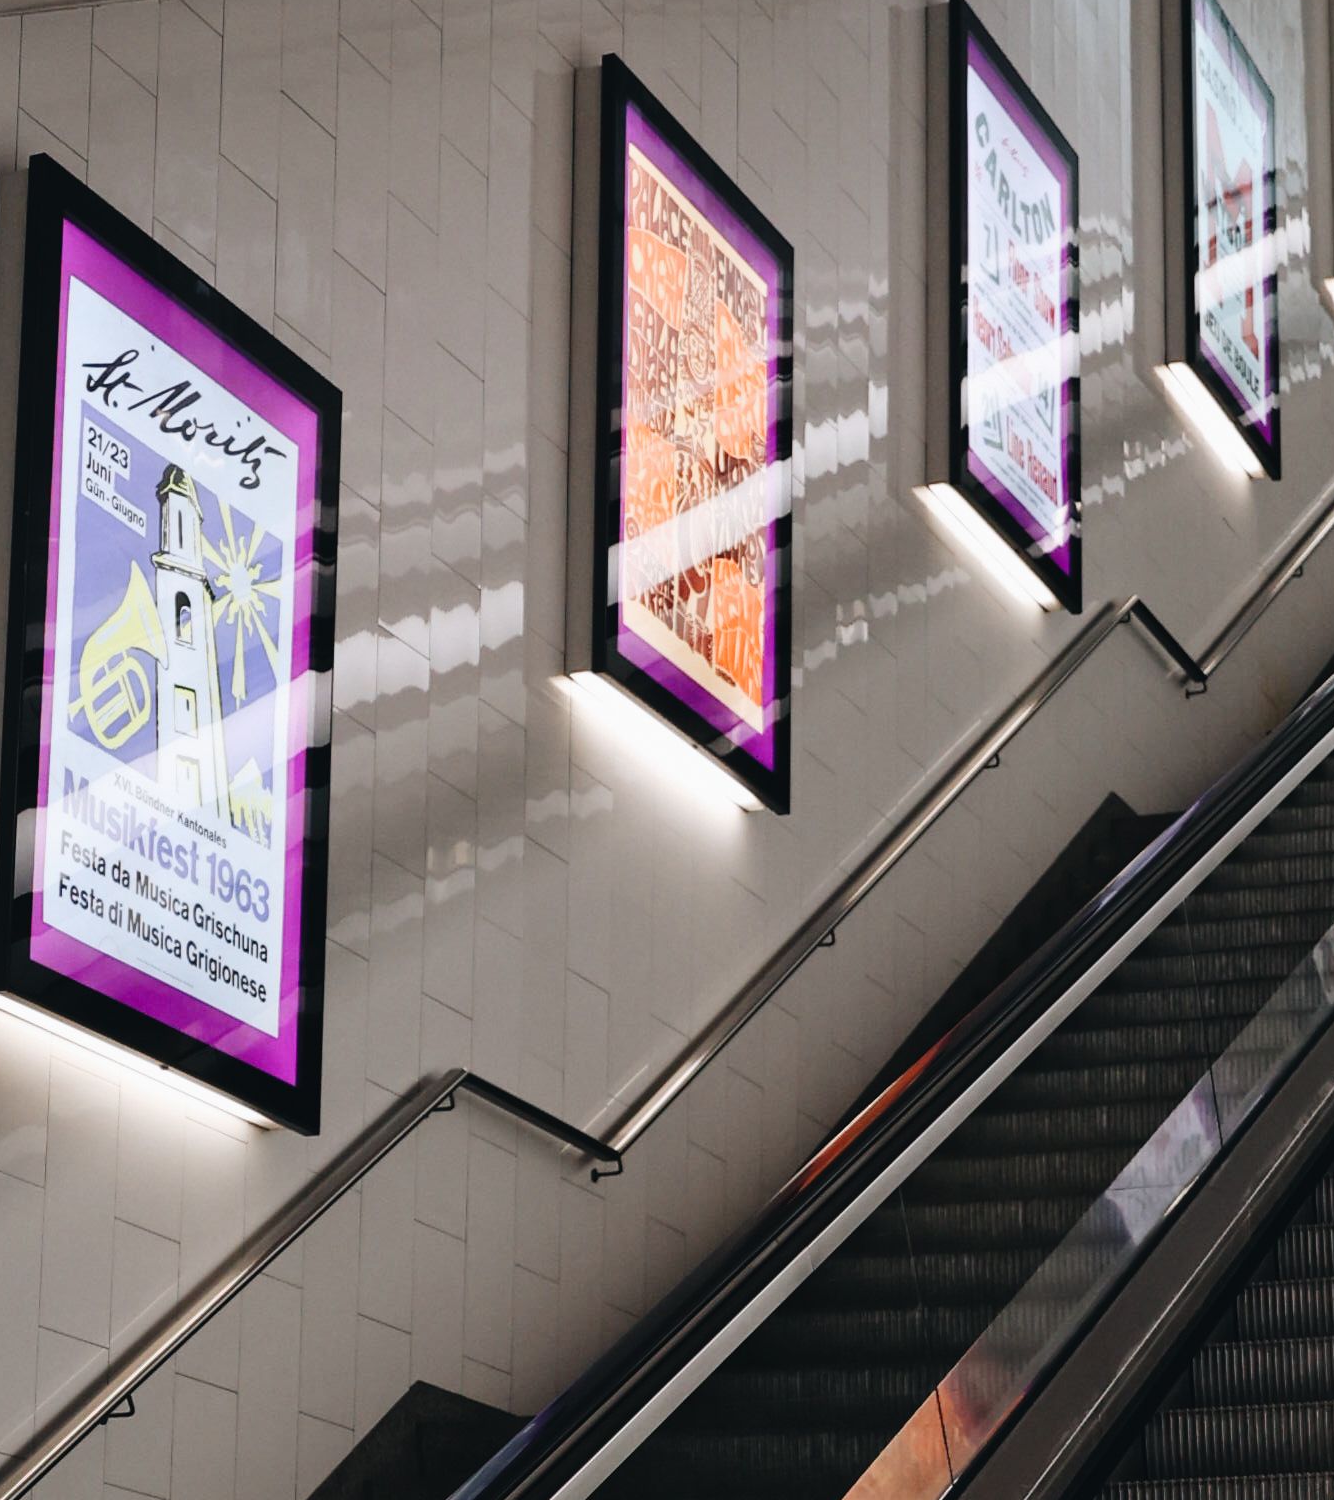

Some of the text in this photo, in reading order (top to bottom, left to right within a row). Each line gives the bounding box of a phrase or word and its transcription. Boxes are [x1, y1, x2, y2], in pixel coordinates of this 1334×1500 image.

[630, 160, 690, 255] PALACE
[974, 112, 1055, 245] CARLTON
[86, 451, 111, 484] Juni
[87, 426, 128, 469] 21/23
[128, 379, 286, 490] Moritz
[110, 494, 144, 528] Giugno
[62, 766, 269, 922] Musikfest 1963
[177, 812, 226, 849] Kantonales
[58, 873, 103, 918] Festa
[108, 900, 122, 927] di
[127, 907, 181, 959] Musica
[185, 939, 266, 1003] Grigionese
[61, 831, 267, 963] Festa da Musica Grischuna
